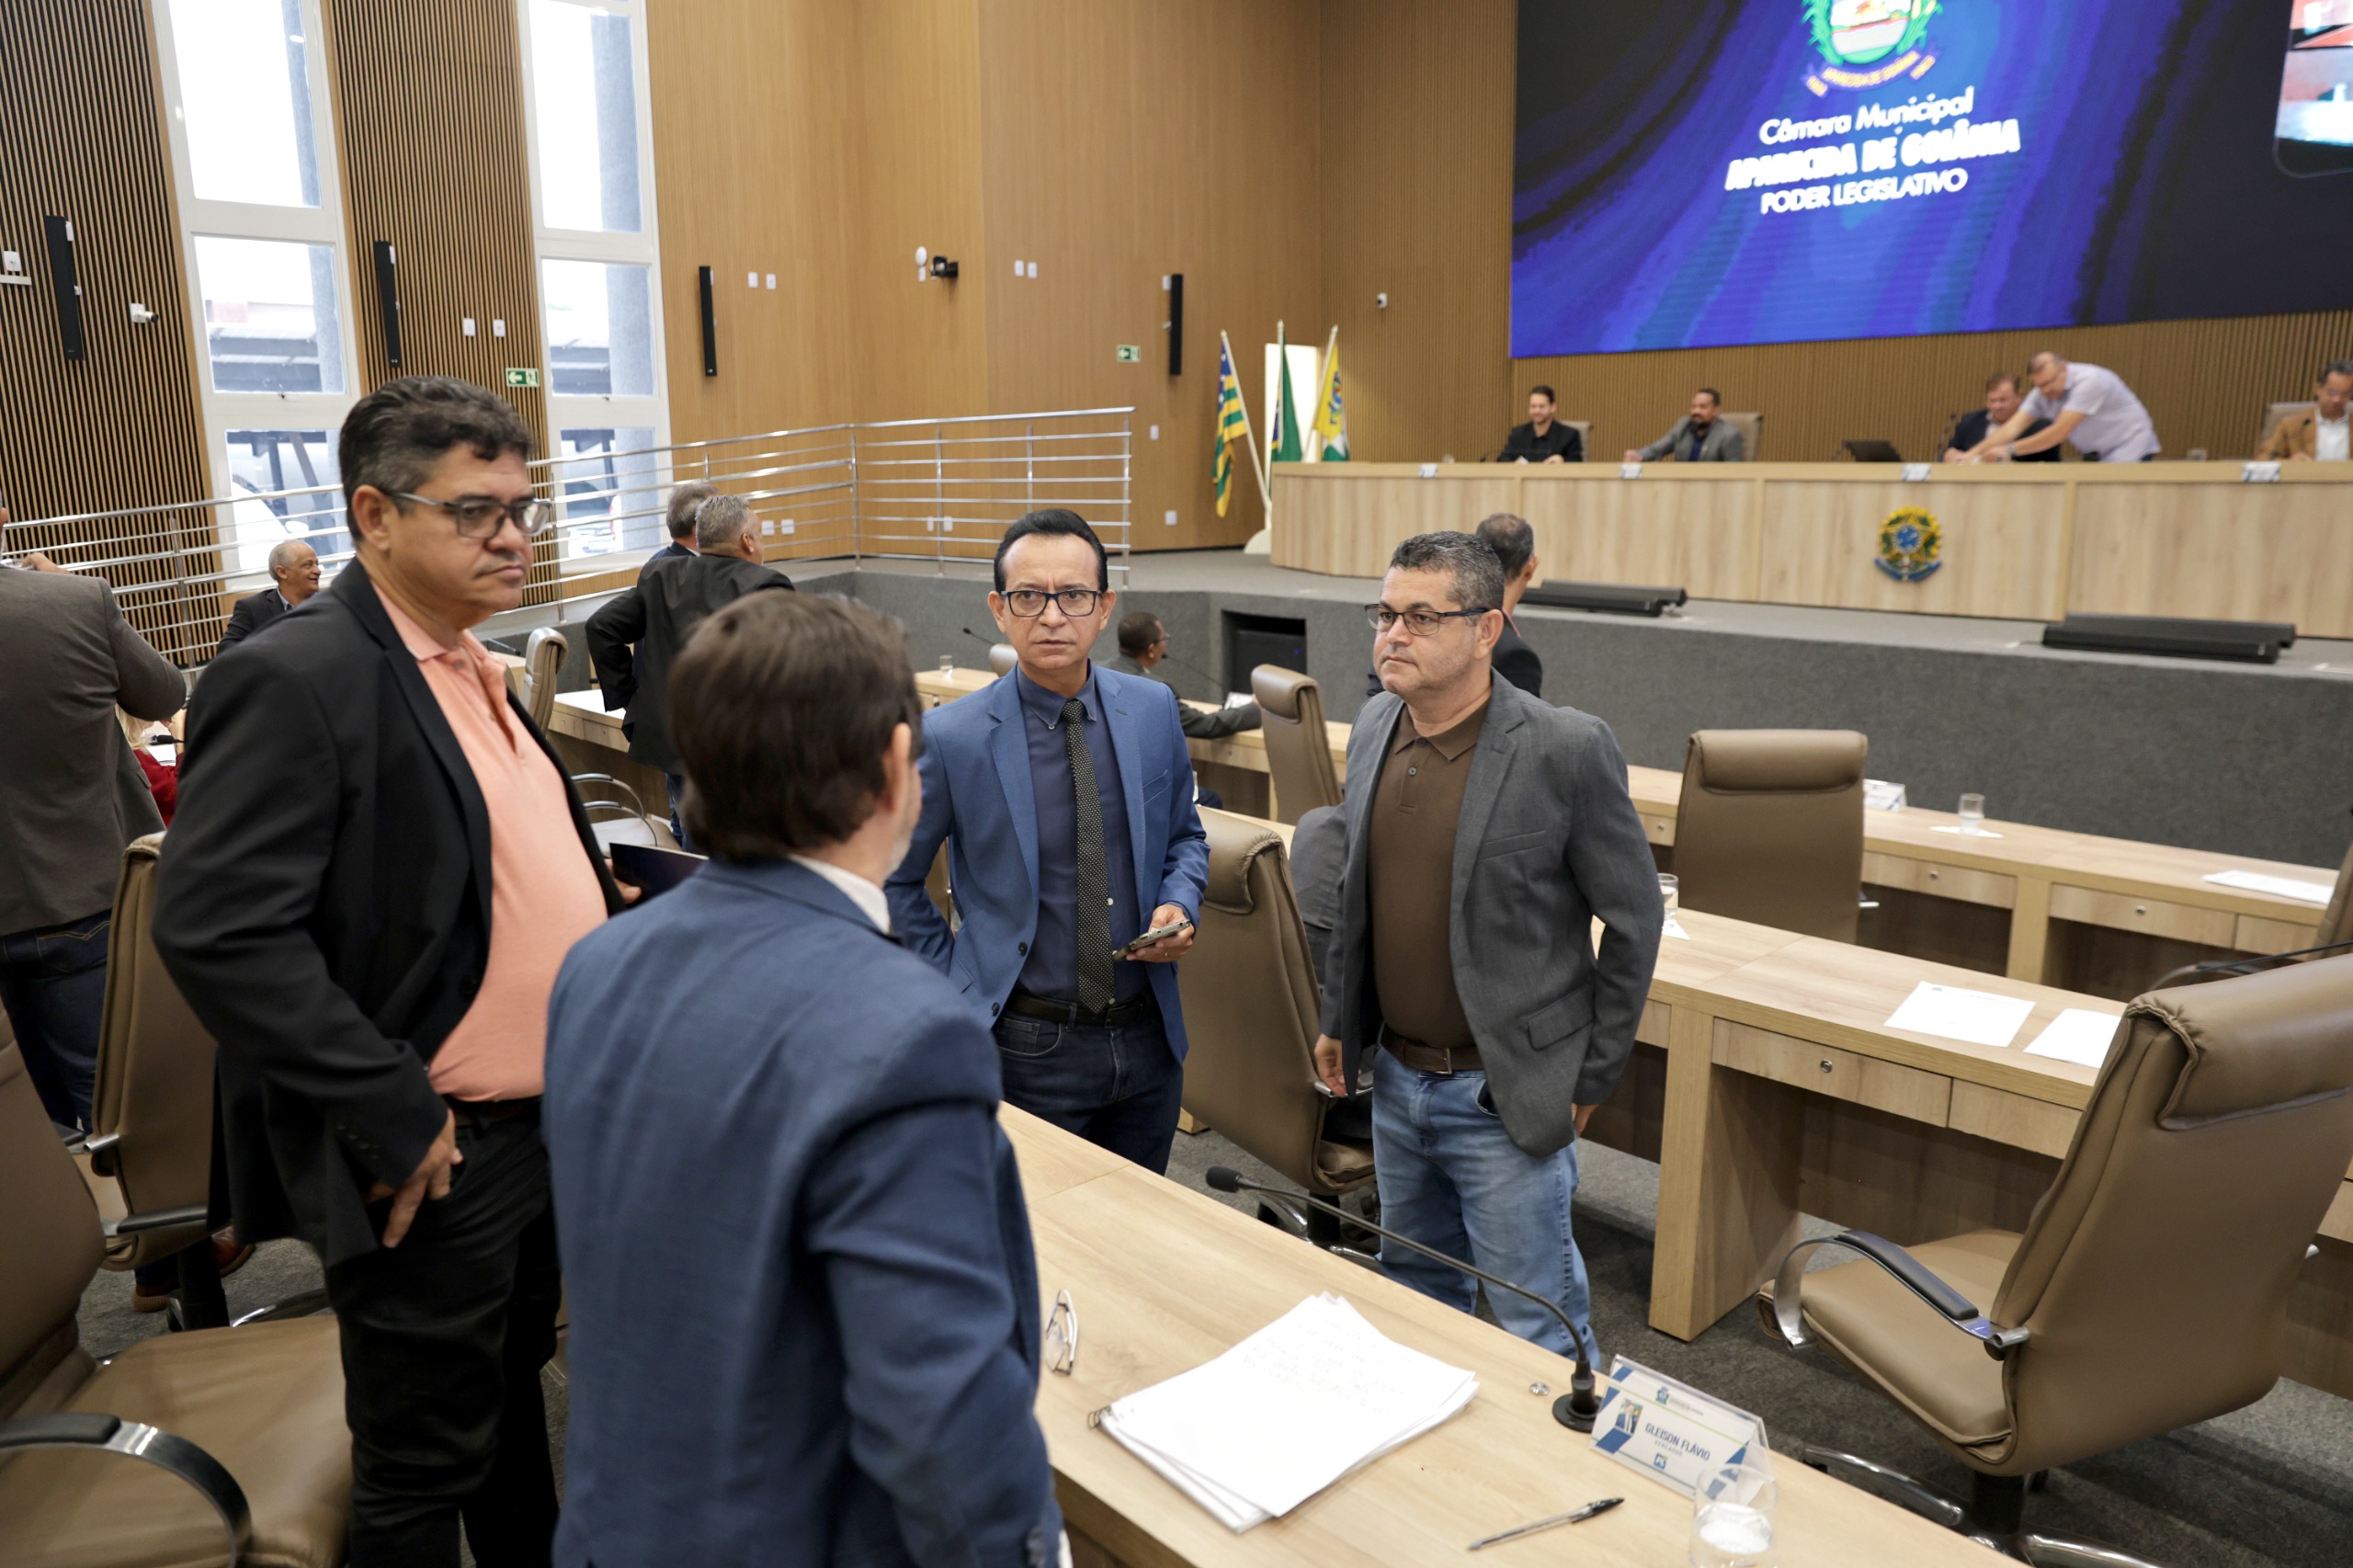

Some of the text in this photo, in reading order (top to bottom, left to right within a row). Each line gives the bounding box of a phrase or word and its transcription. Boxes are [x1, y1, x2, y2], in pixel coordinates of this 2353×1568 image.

[1759, 115, 1852, 144] Câmara
[1855, 85, 1974, 131] Municipal
[1760, 168, 1969, 215] PODER LEGISLATIVO
[1645, 1422, 1711, 1461] GLEISON FLÁVIO
